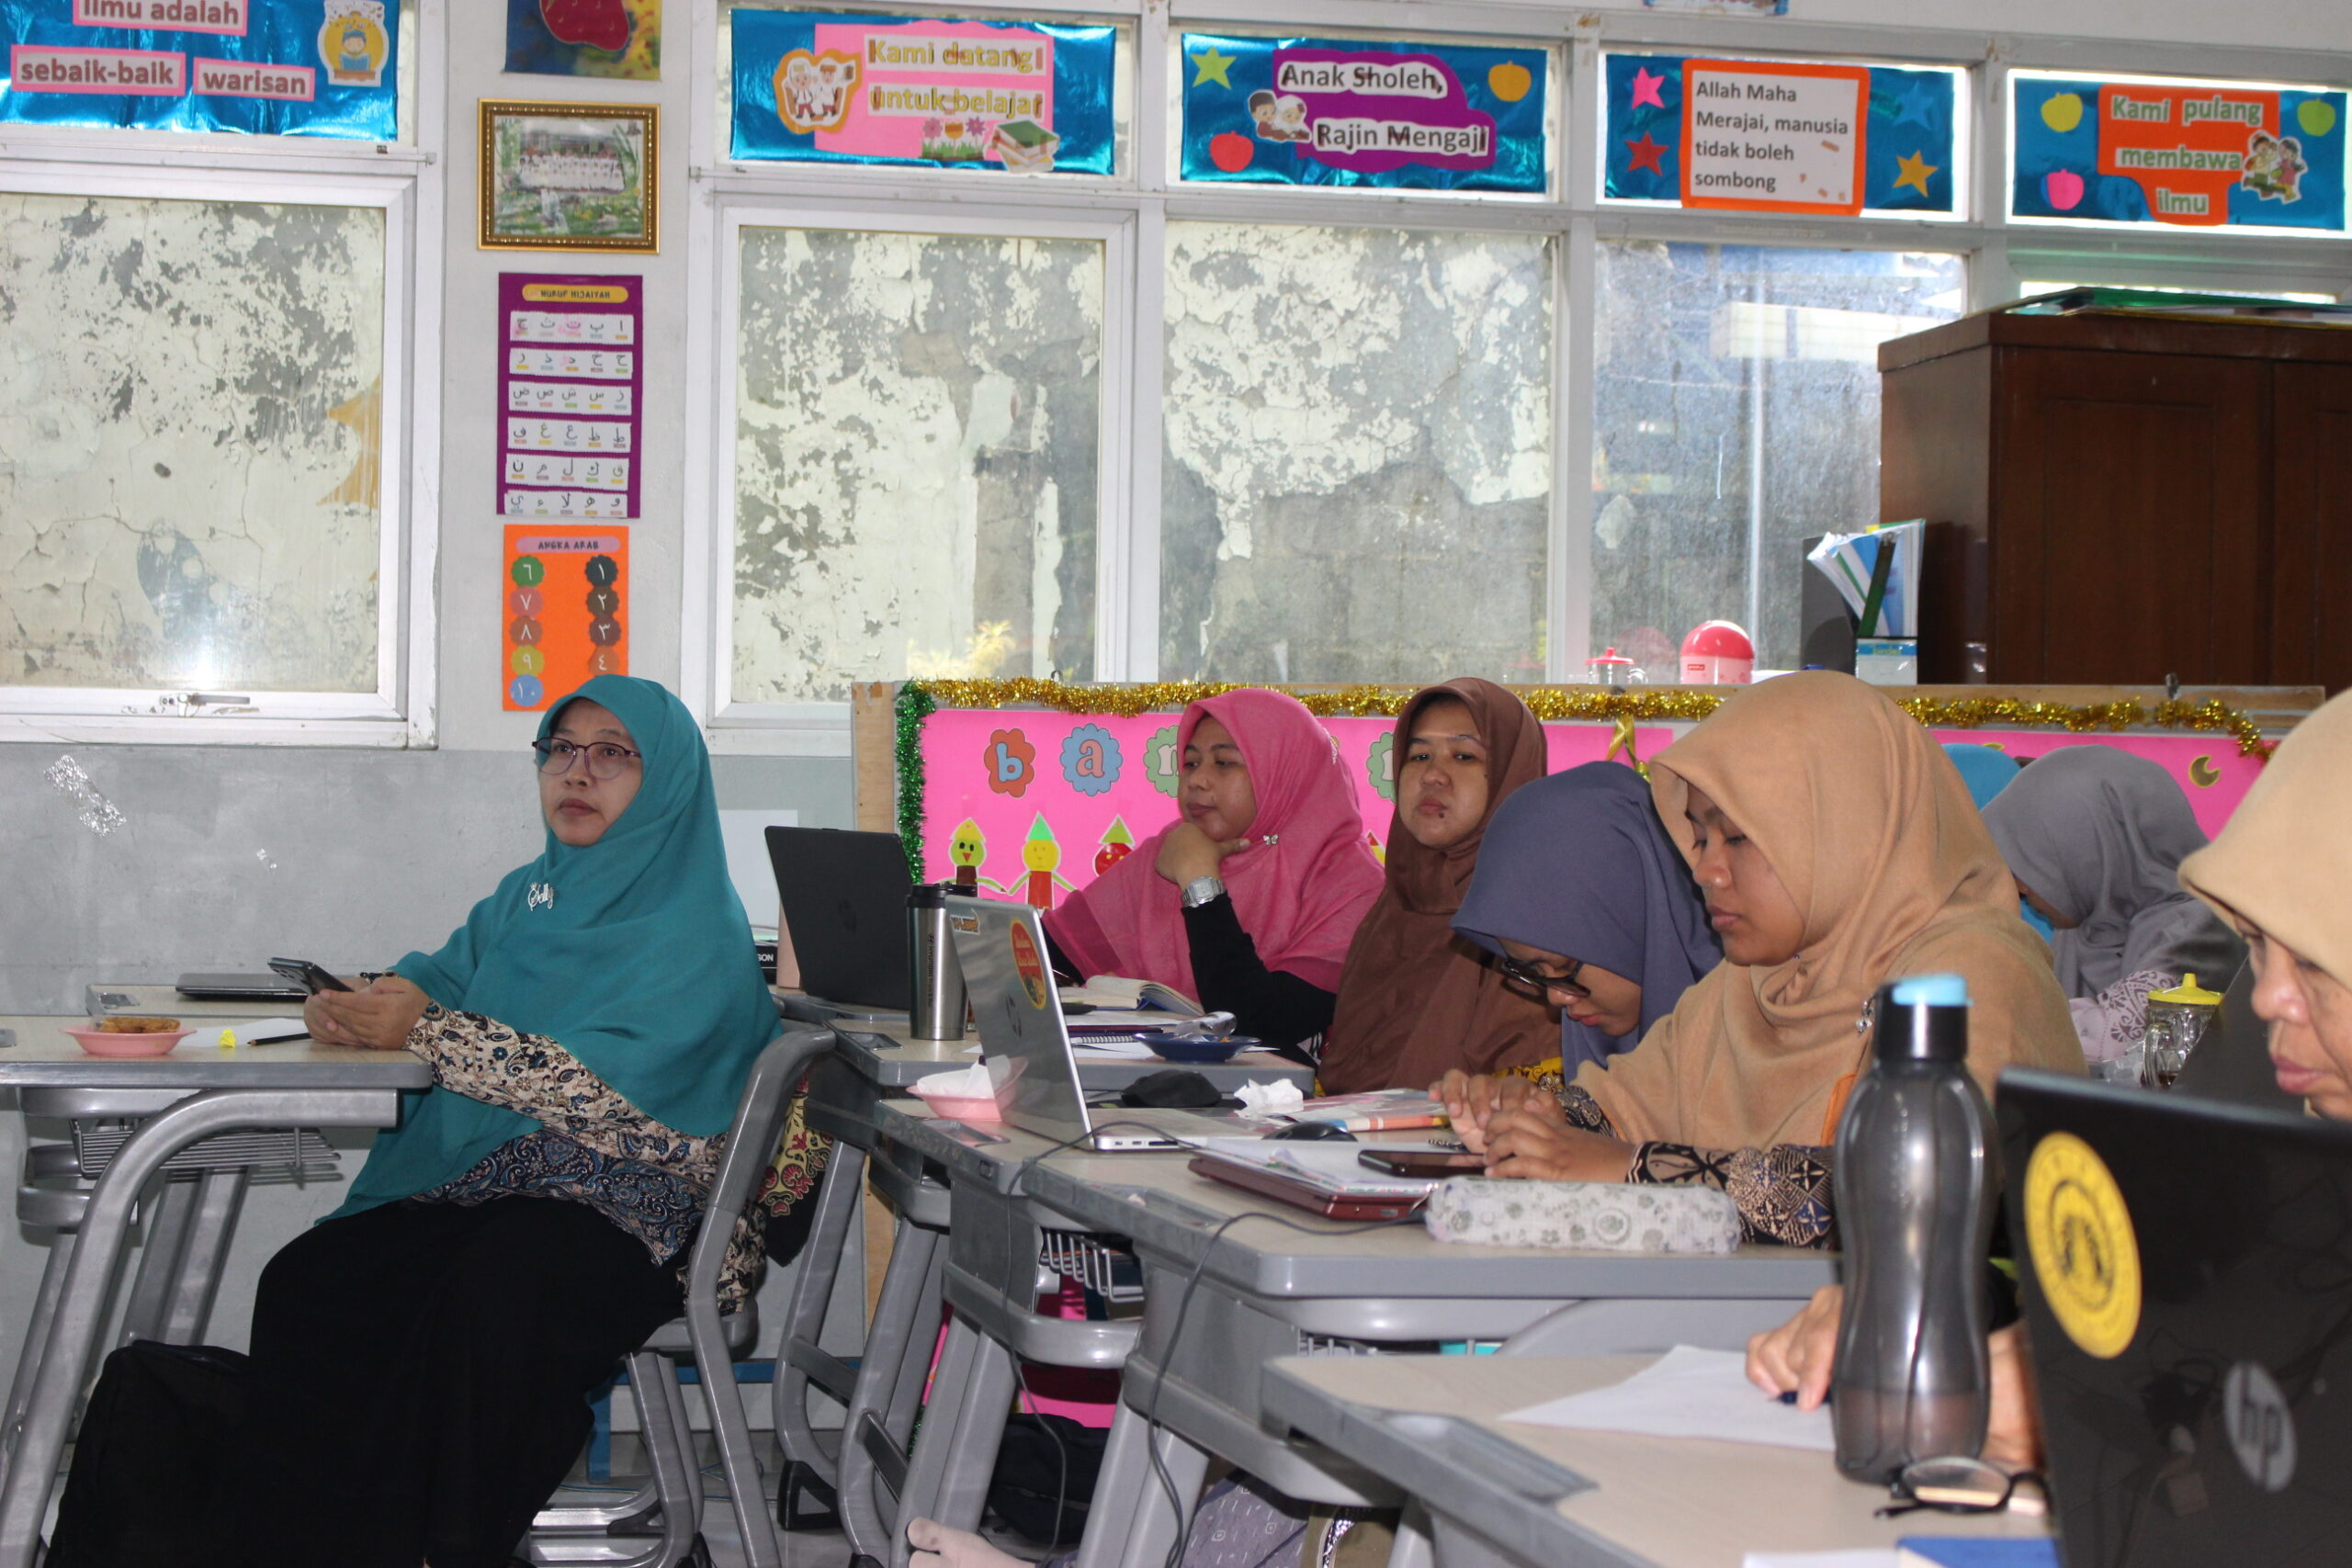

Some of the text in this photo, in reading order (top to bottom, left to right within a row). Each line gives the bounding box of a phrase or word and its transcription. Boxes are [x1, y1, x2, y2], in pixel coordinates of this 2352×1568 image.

[151, 0, 239, 25] adalah
[868, 39, 1033, 73] Kami datang
[20, 57, 306, 96] sebaik-baik warisan
[1281, 63, 1443, 93] Anak Sholeh,
[954, 90, 1042, 118] belajar
[1696, 81, 1797, 103] Allah Maha
[1696, 111, 1849, 135] Merajai, manusia
[2112, 96, 2263, 126] Kami pulang
[1317, 123, 1487, 152] Rajin Mengaji
[1695, 141, 1795, 161] tidak boleh
[2120, 145, 2242, 169] membawa
[1695, 171, 1777, 193] sombong
[2156, 188, 2208, 214] ilmu
[537, 541, 570, 550] ANGKA
